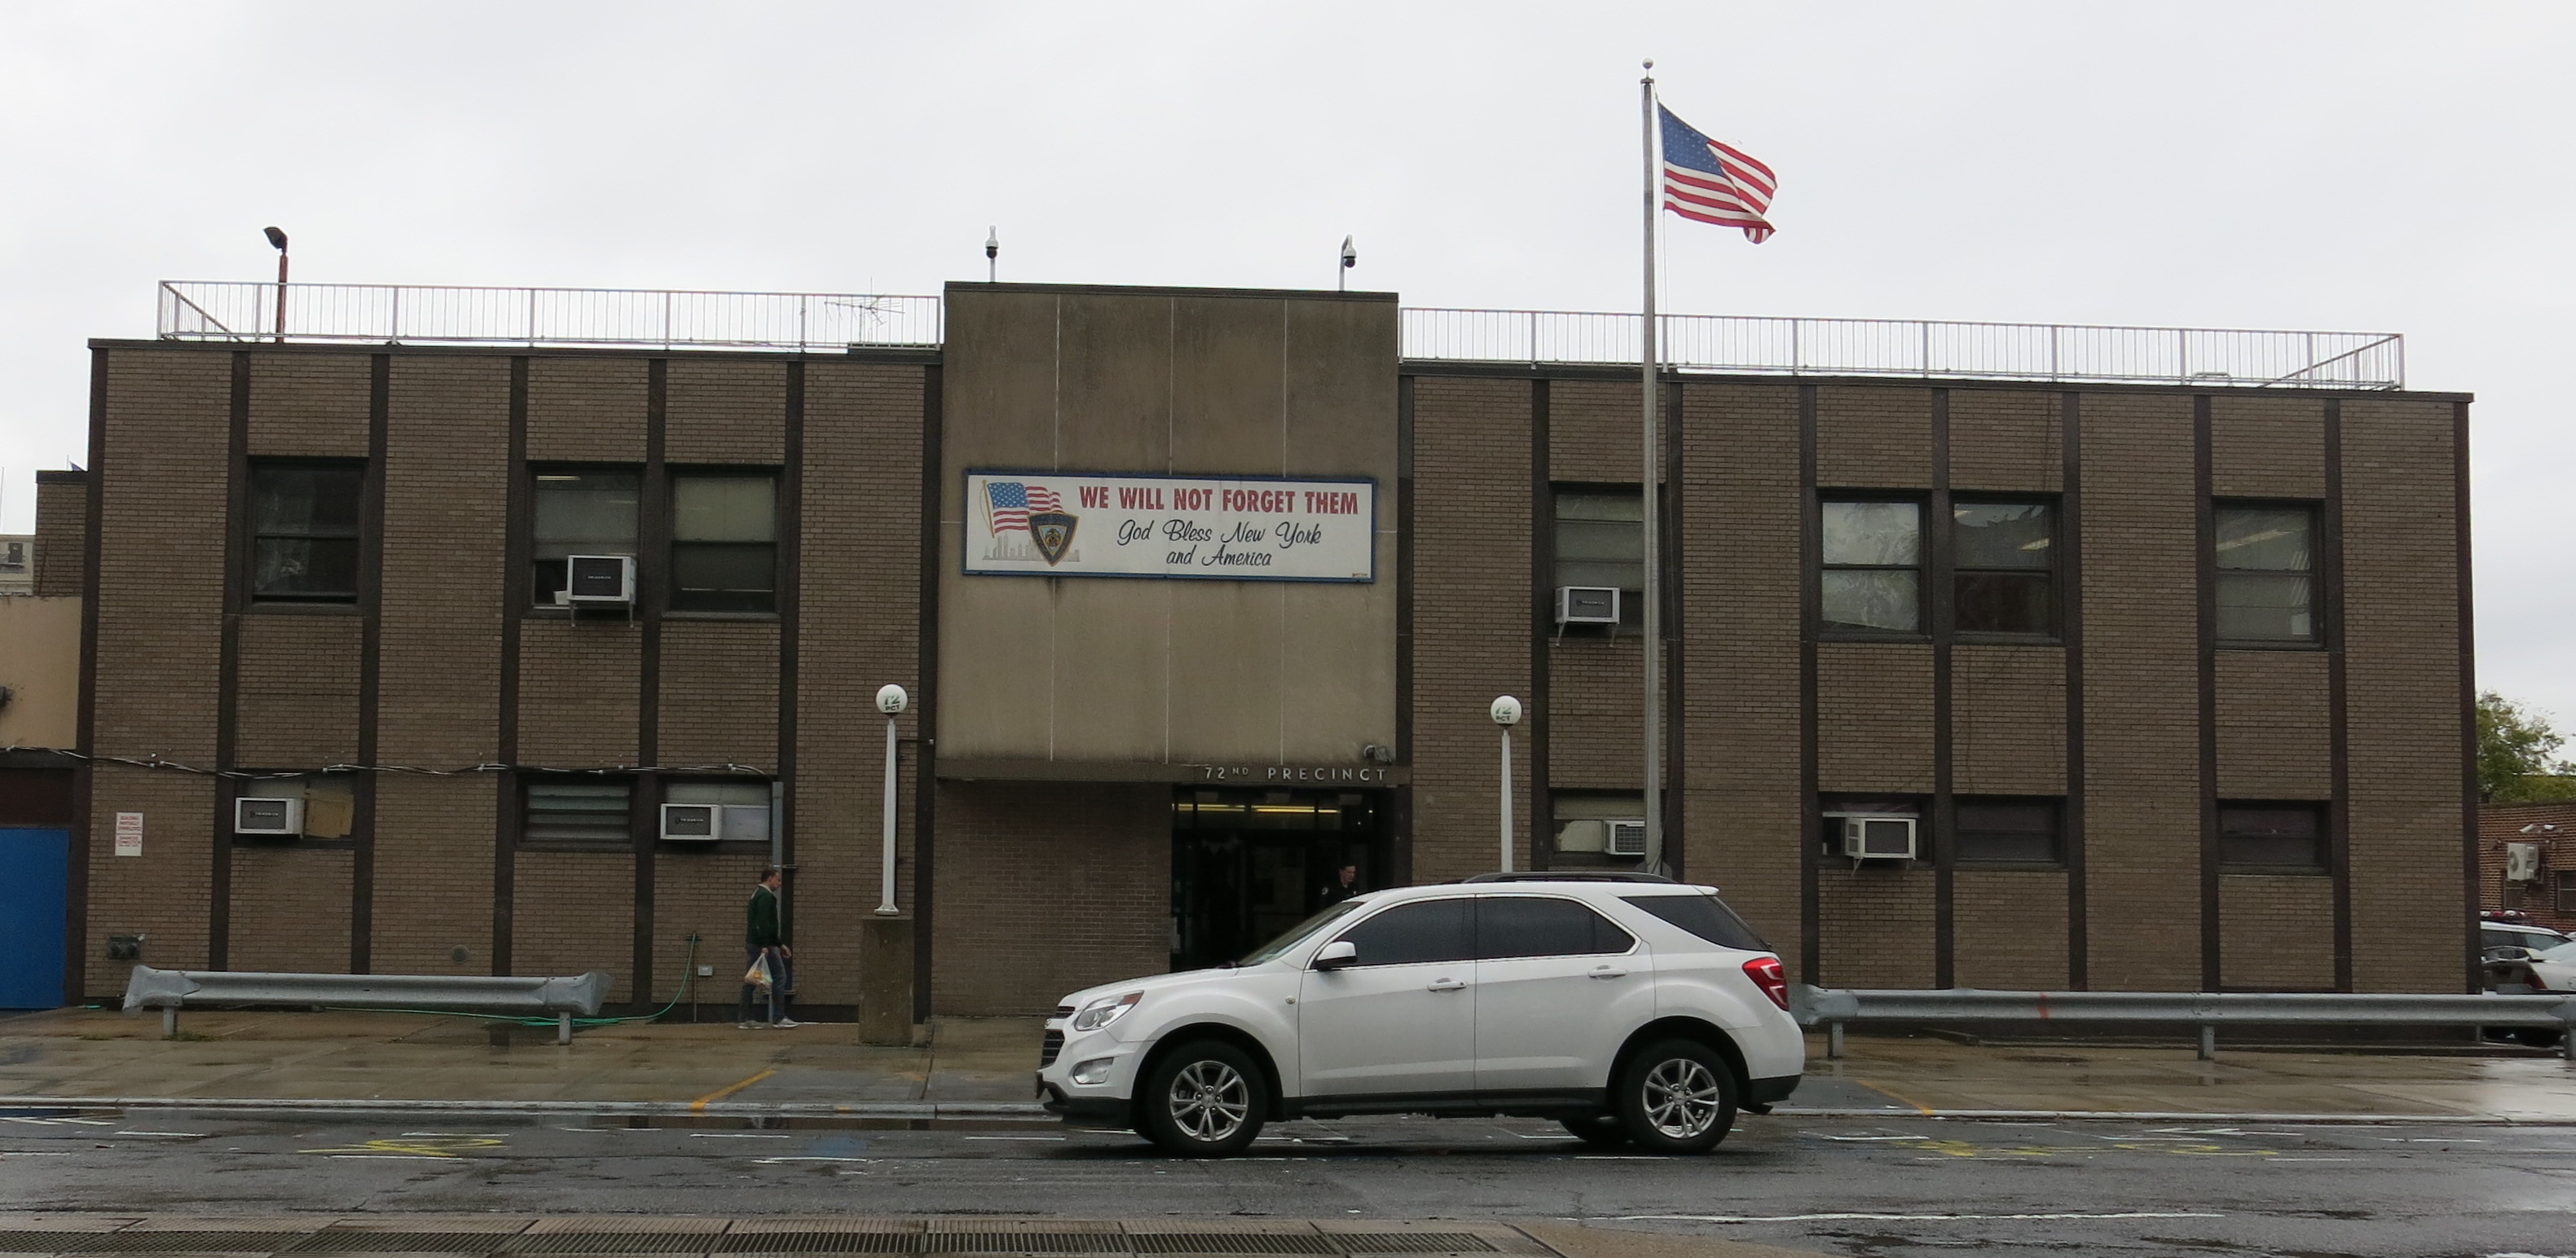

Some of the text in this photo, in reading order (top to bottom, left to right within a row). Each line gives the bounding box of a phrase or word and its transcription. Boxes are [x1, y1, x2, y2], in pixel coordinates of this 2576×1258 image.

[1079, 486, 1359, 515] WE WILL NOT FORGET THEM
[1116, 519, 1322, 549] God Bless New York
[1166, 543, 1273, 566] and America
[1267, 767, 1385, 781] PRECINCT
